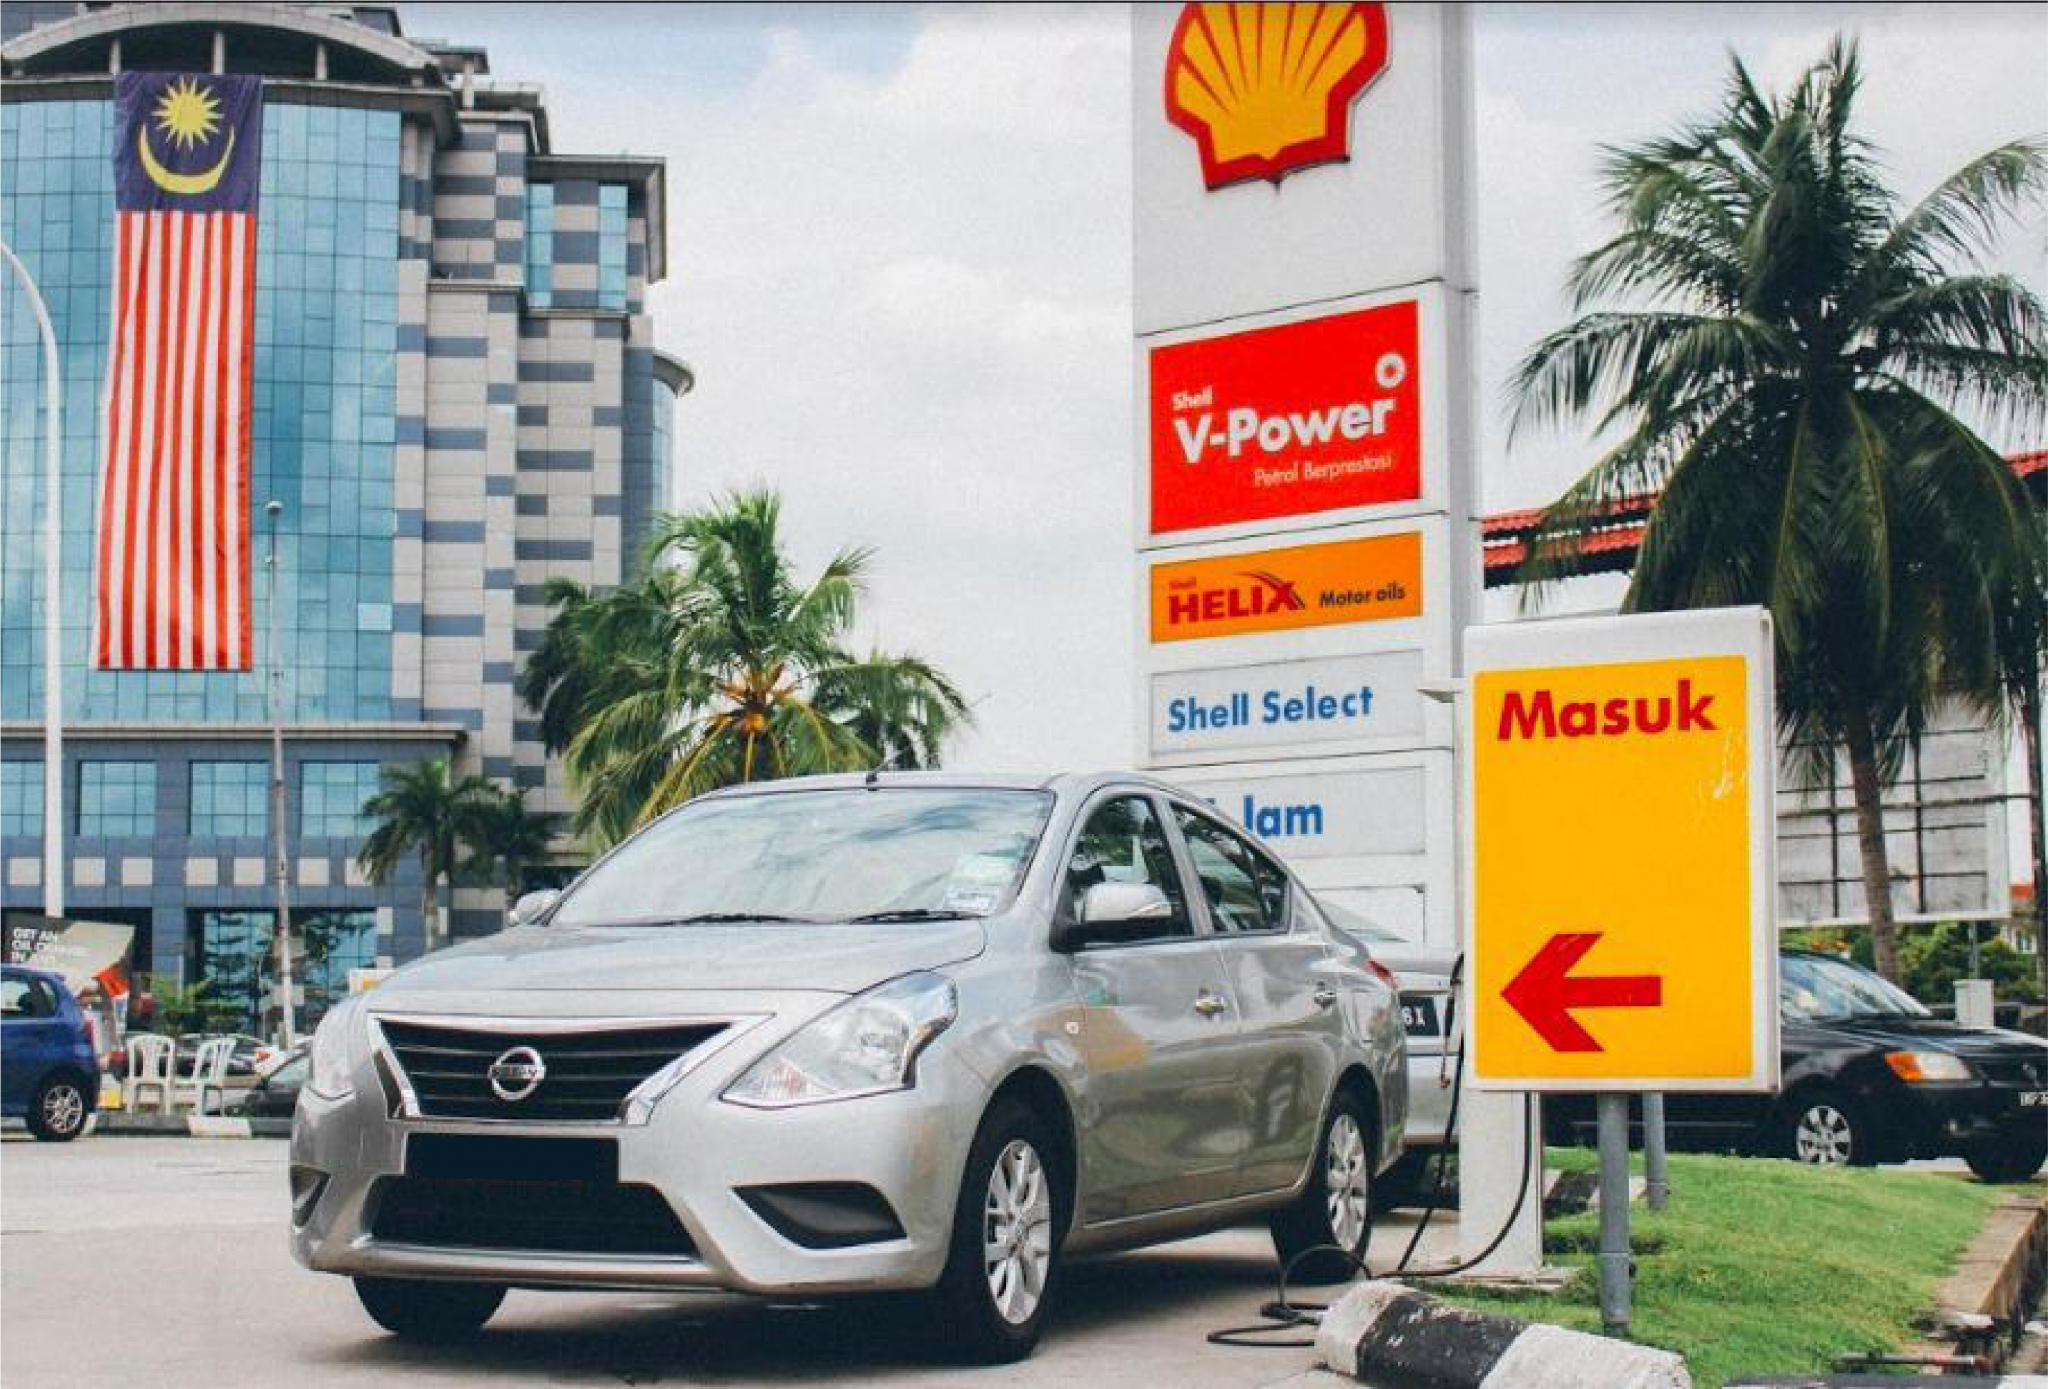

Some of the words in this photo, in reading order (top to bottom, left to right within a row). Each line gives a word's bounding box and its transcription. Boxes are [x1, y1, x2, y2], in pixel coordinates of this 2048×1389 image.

[1173, 398, 1396, 464] V-Power
[1169, 575, 1304, 625] HELIX
[1319, 589, 1371, 608] Motor
[1376, 580, 1405, 600] oils
[1167, 696, 1249, 733] Shell
[1262, 686, 1374, 724] Select
[1497, 678, 1718, 742] Masuk
